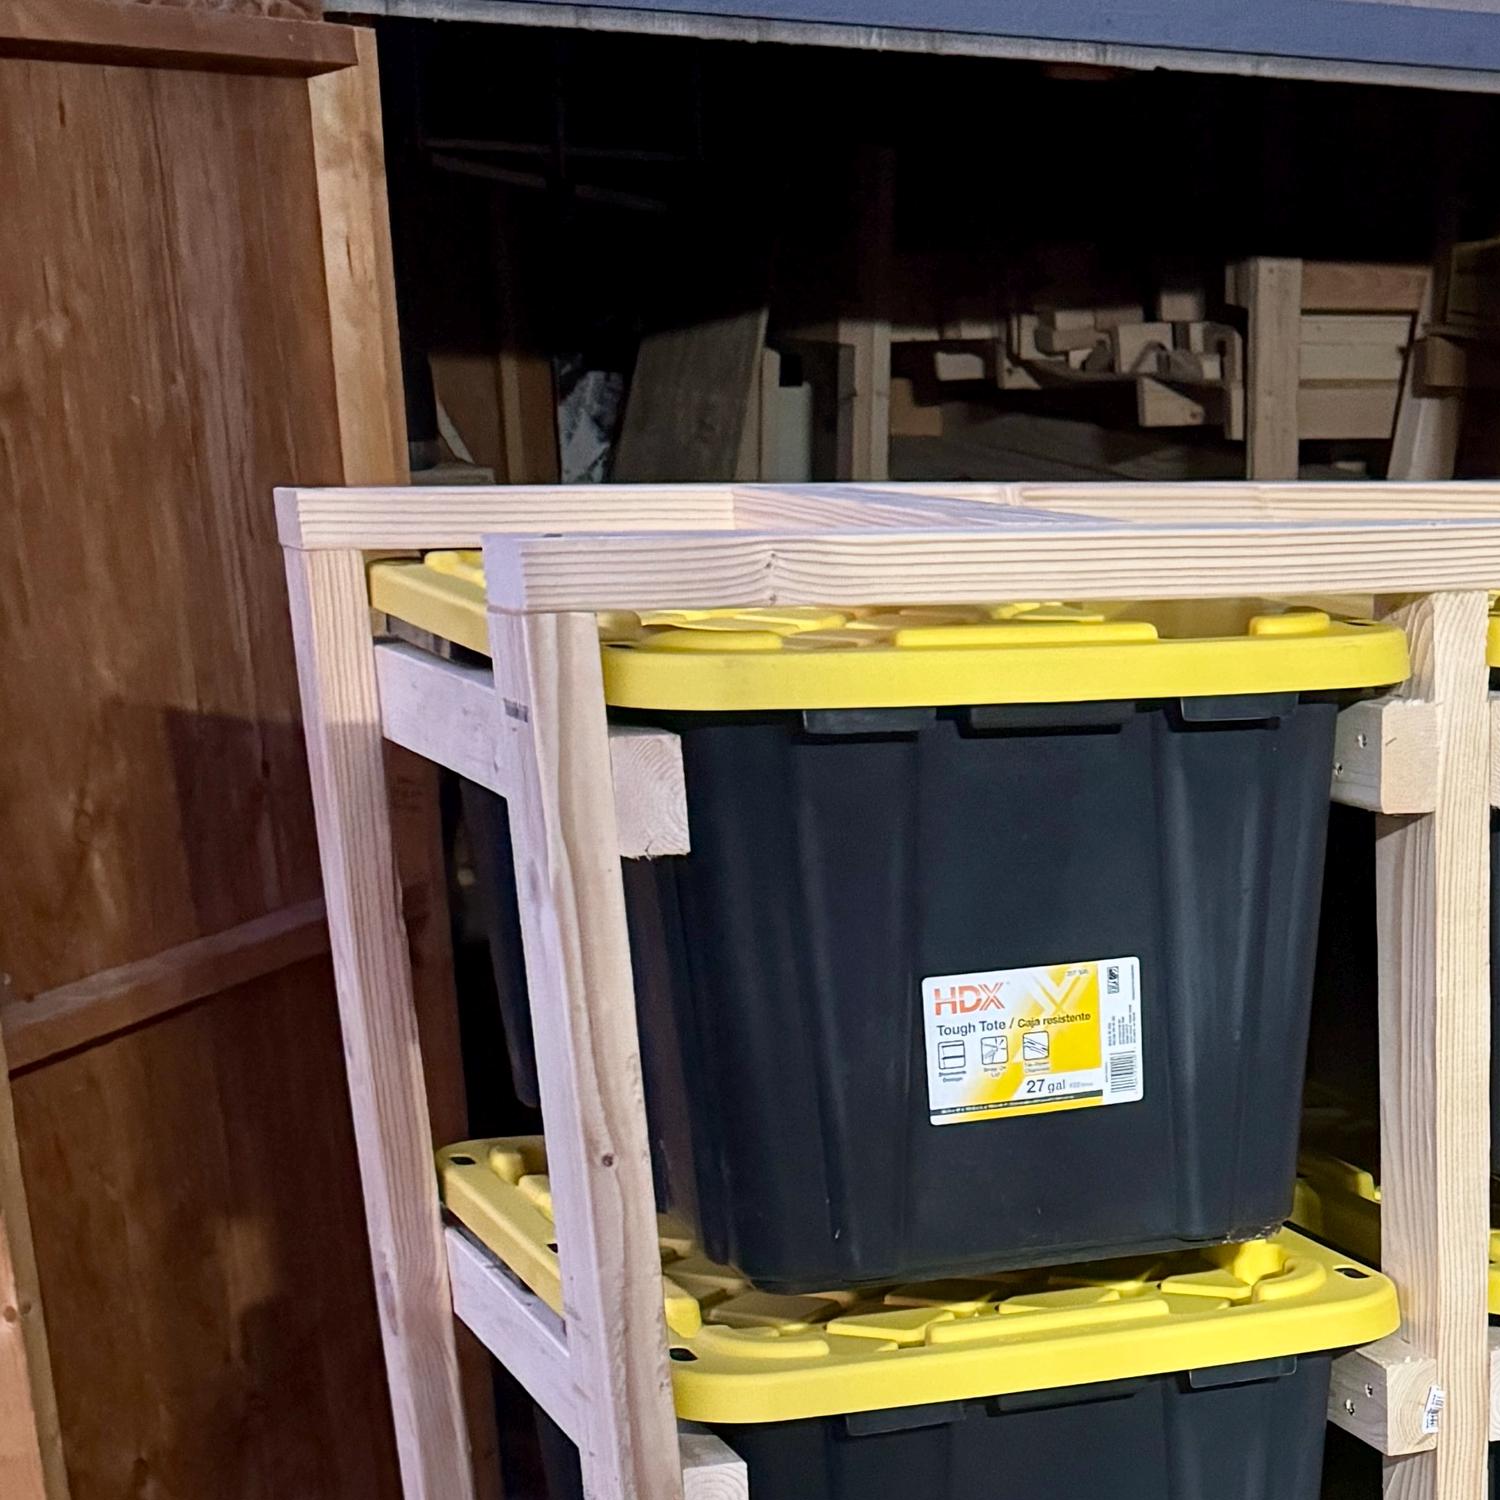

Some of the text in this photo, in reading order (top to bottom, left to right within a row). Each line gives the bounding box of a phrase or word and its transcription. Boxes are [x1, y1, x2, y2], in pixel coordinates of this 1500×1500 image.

[934, 983, 1005, 1015] HDX
[937, 1023, 975, 1036] Tough
[980, 1020, 1005, 1032] Tote
[1018, 1016, 1040, 1028] Caja
[1044, 1013, 1091, 1024] resistente
[1027, 1079, 1045, 1092] 27
[1048, 1080, 1065, 1093] gal
